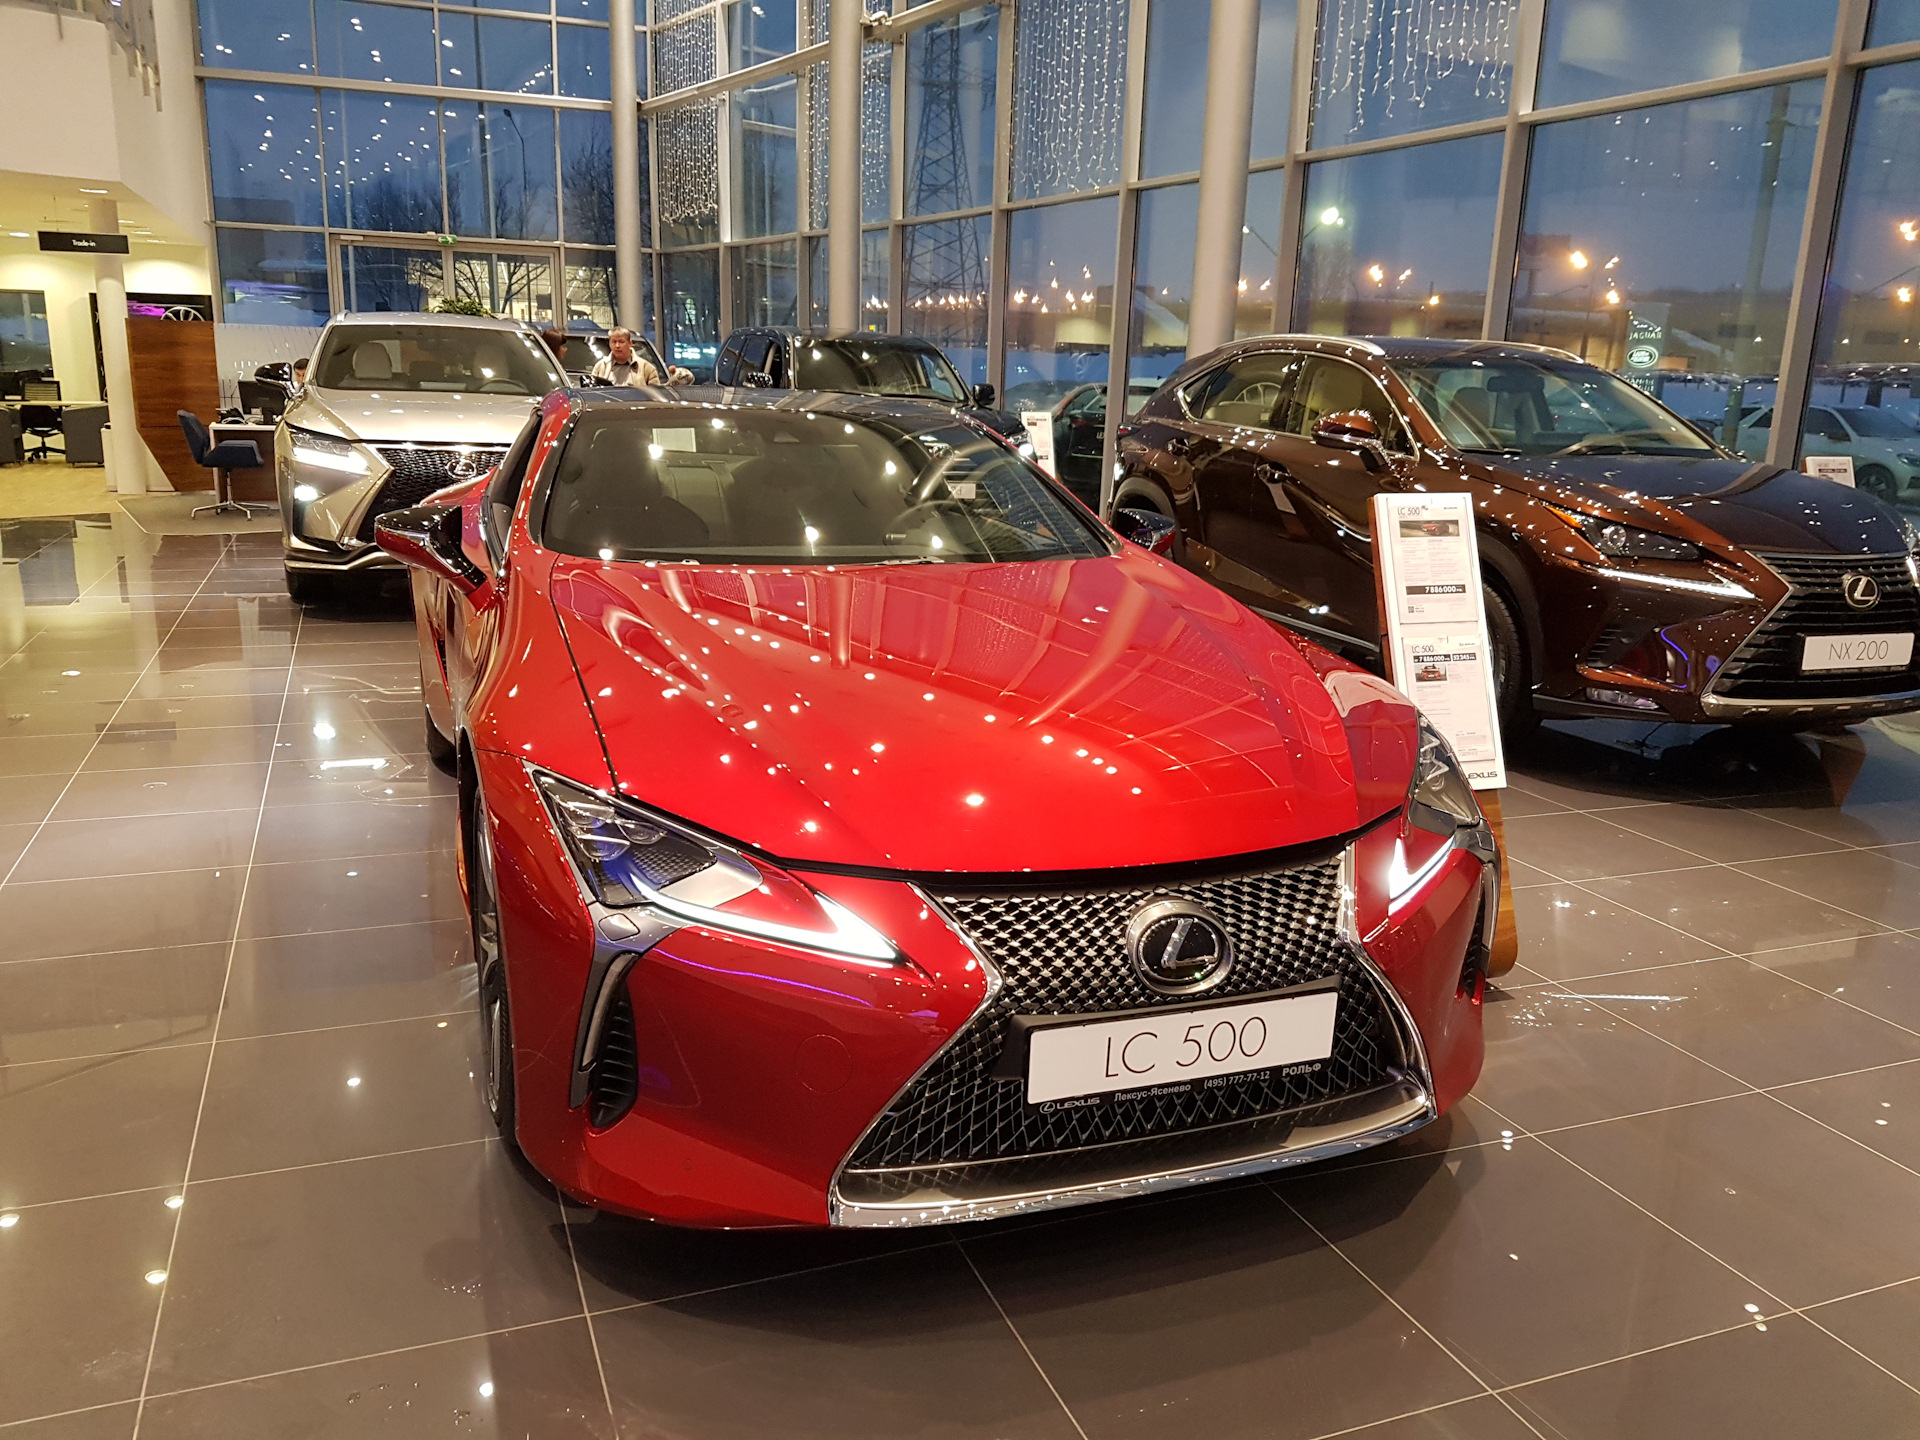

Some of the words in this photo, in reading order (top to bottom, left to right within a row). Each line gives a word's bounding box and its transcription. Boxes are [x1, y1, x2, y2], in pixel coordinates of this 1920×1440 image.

[71, 239, 96, 247] Trade-in
[1397, 507, 1406, 516] LC
[1407, 506, 1420, 516] 500
[1411, 645, 1420, 654] LC
[1421, 645, 1435, 653] 500
[1828, 642, 1853, 660] NX
[1855, 640, 1889, 660] 200
[1467, 771, 1498, 780] EXUS
[1104, 1031, 1158, 1078] LC
[1175, 1016, 1267, 1067] 500
[1282, 1062, 1322, 1077] РОЛЬФ
[1203, 1076, 1227, 1089] (495)
[1228, 1071, 1270, 1085] 777-77-12
[1114, 1084, 1192, 1102] Лексус-Ясенево
[1056, 1097, 1100, 1110] LEXUS
